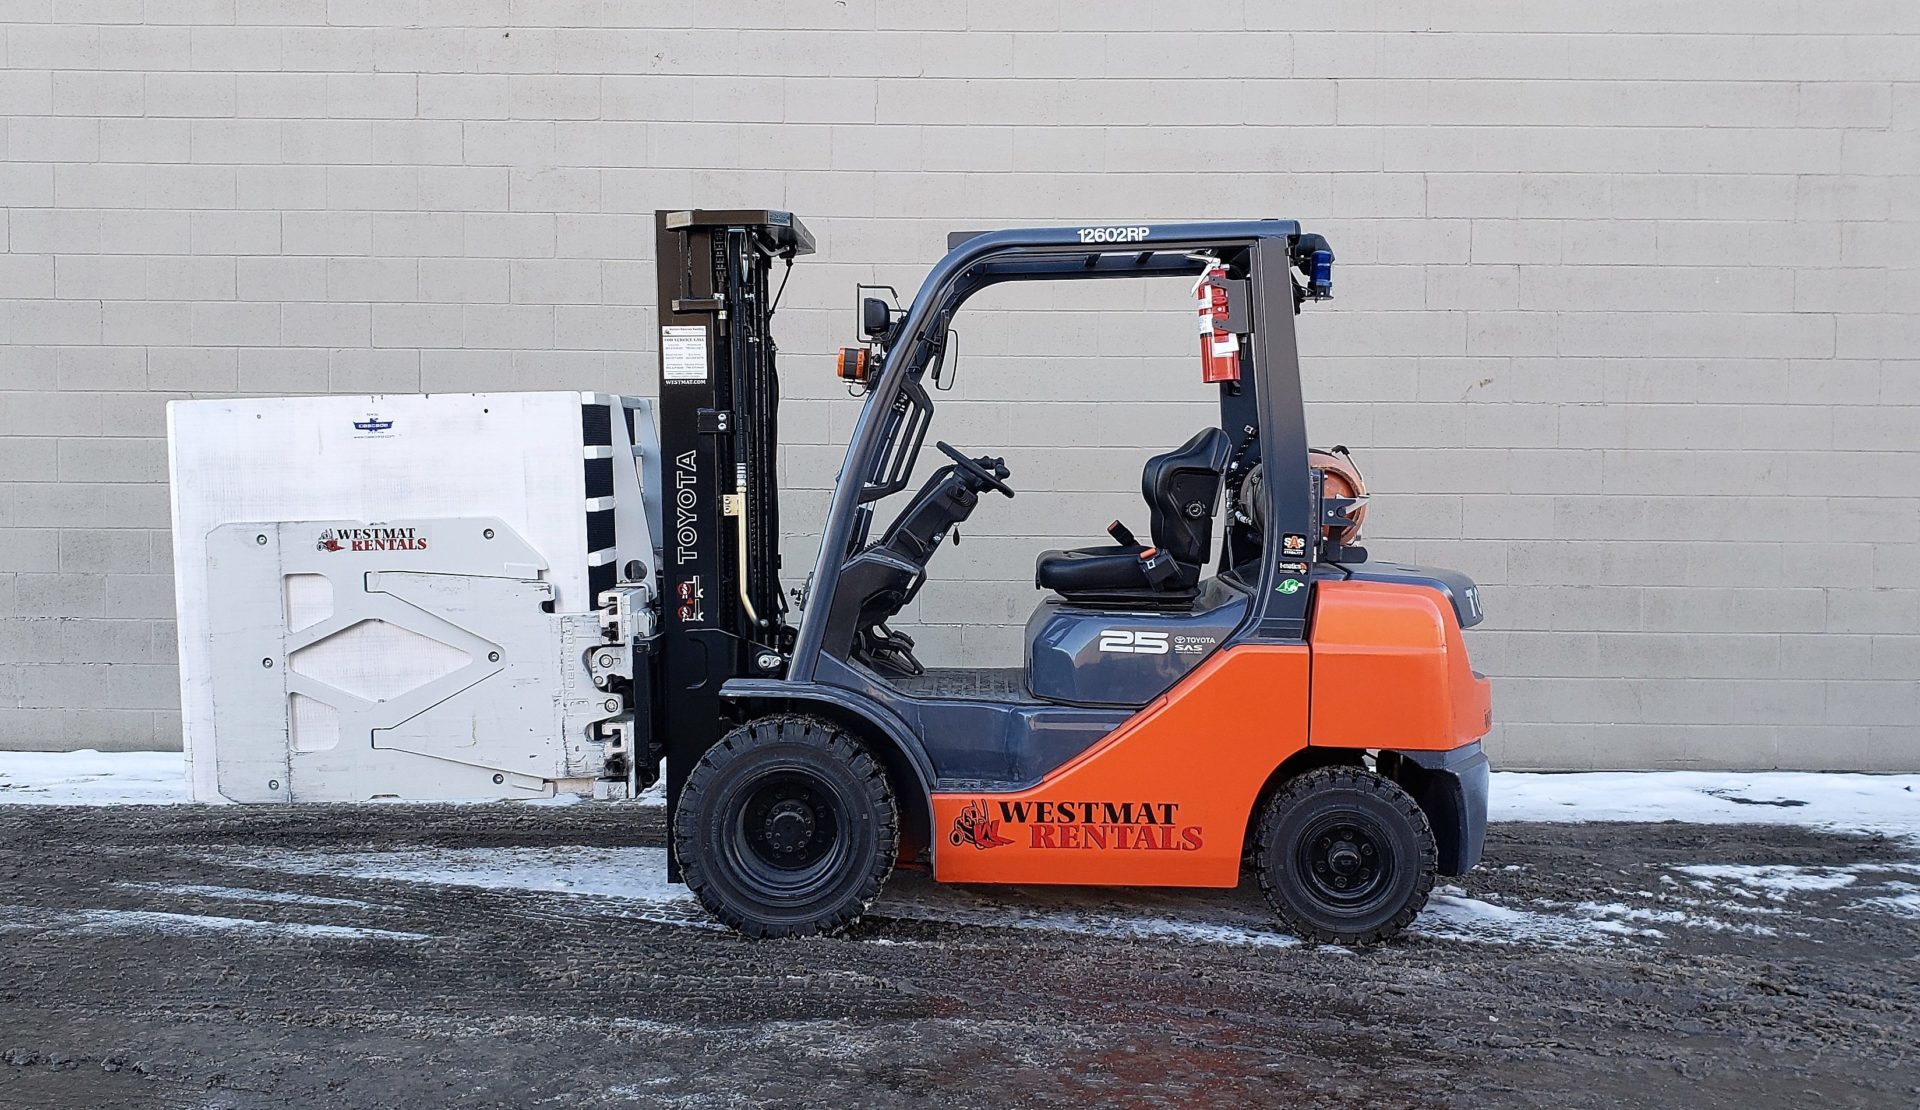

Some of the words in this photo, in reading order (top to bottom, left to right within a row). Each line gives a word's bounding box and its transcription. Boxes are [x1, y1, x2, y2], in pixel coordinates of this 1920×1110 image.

[1077, 227, 1150, 243] 12602RP
[676, 450, 698, 565] TOYOTA
[337, 528, 416, 540] WESTMAT
[351, 538, 427, 551] RENTALS
[1283, 536, 1305, 549] SAS
[1099, 630, 1169, 655] 25
[1186, 636, 1216, 644] TOYOTA
[998, 801, 1179, 825] WESTMAT
[1029, 824, 1203, 851] RENTALS
